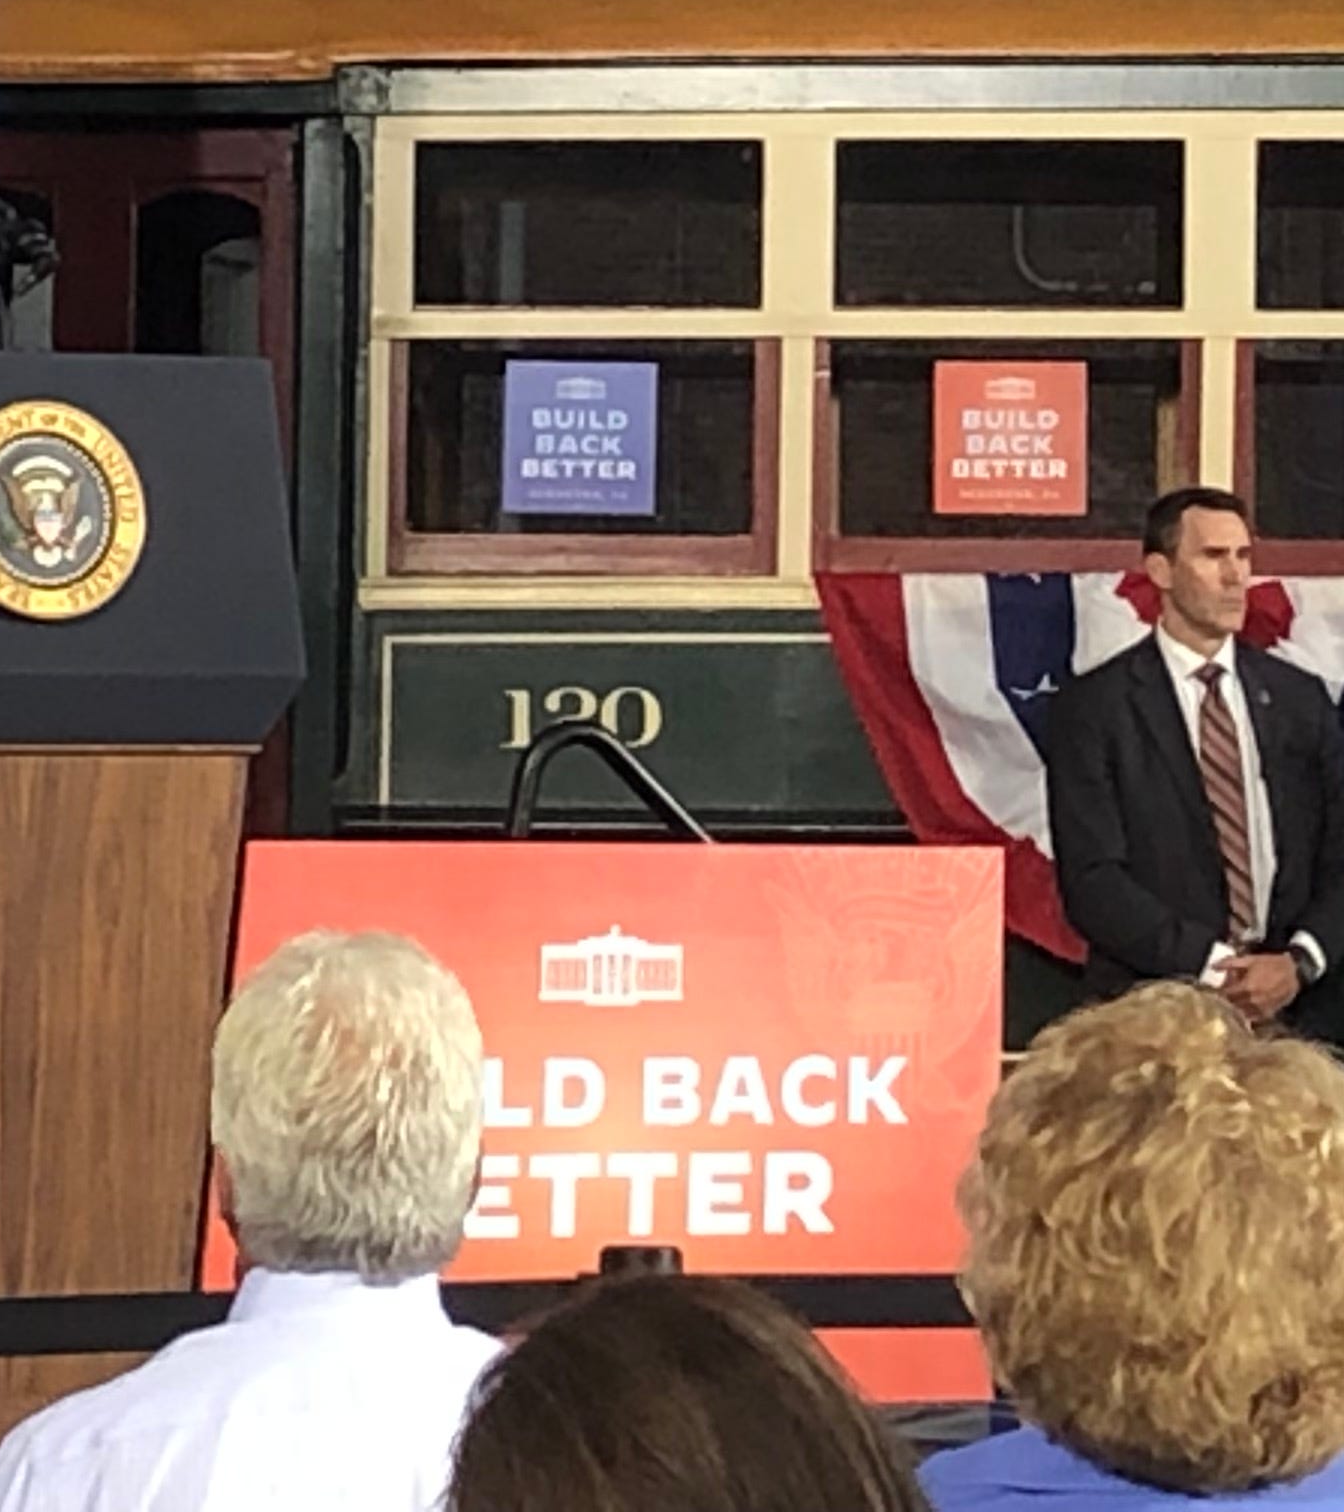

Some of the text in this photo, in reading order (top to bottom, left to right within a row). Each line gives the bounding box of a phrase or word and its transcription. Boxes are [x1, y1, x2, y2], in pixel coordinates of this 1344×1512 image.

[532, 408, 628, 430] BUILD
[962, 408, 1059, 430] BUILD
[535, 434, 622, 455] BACK
[966, 434, 1053, 455] BACK
[521, 458, 637, 480] BETTER
[952, 458, 1068, 478] BETTER
[499, 686, 663, 749] 120
[642, 1054, 909, 1127] BACK
[463, 1150, 834, 1239] ETTER
